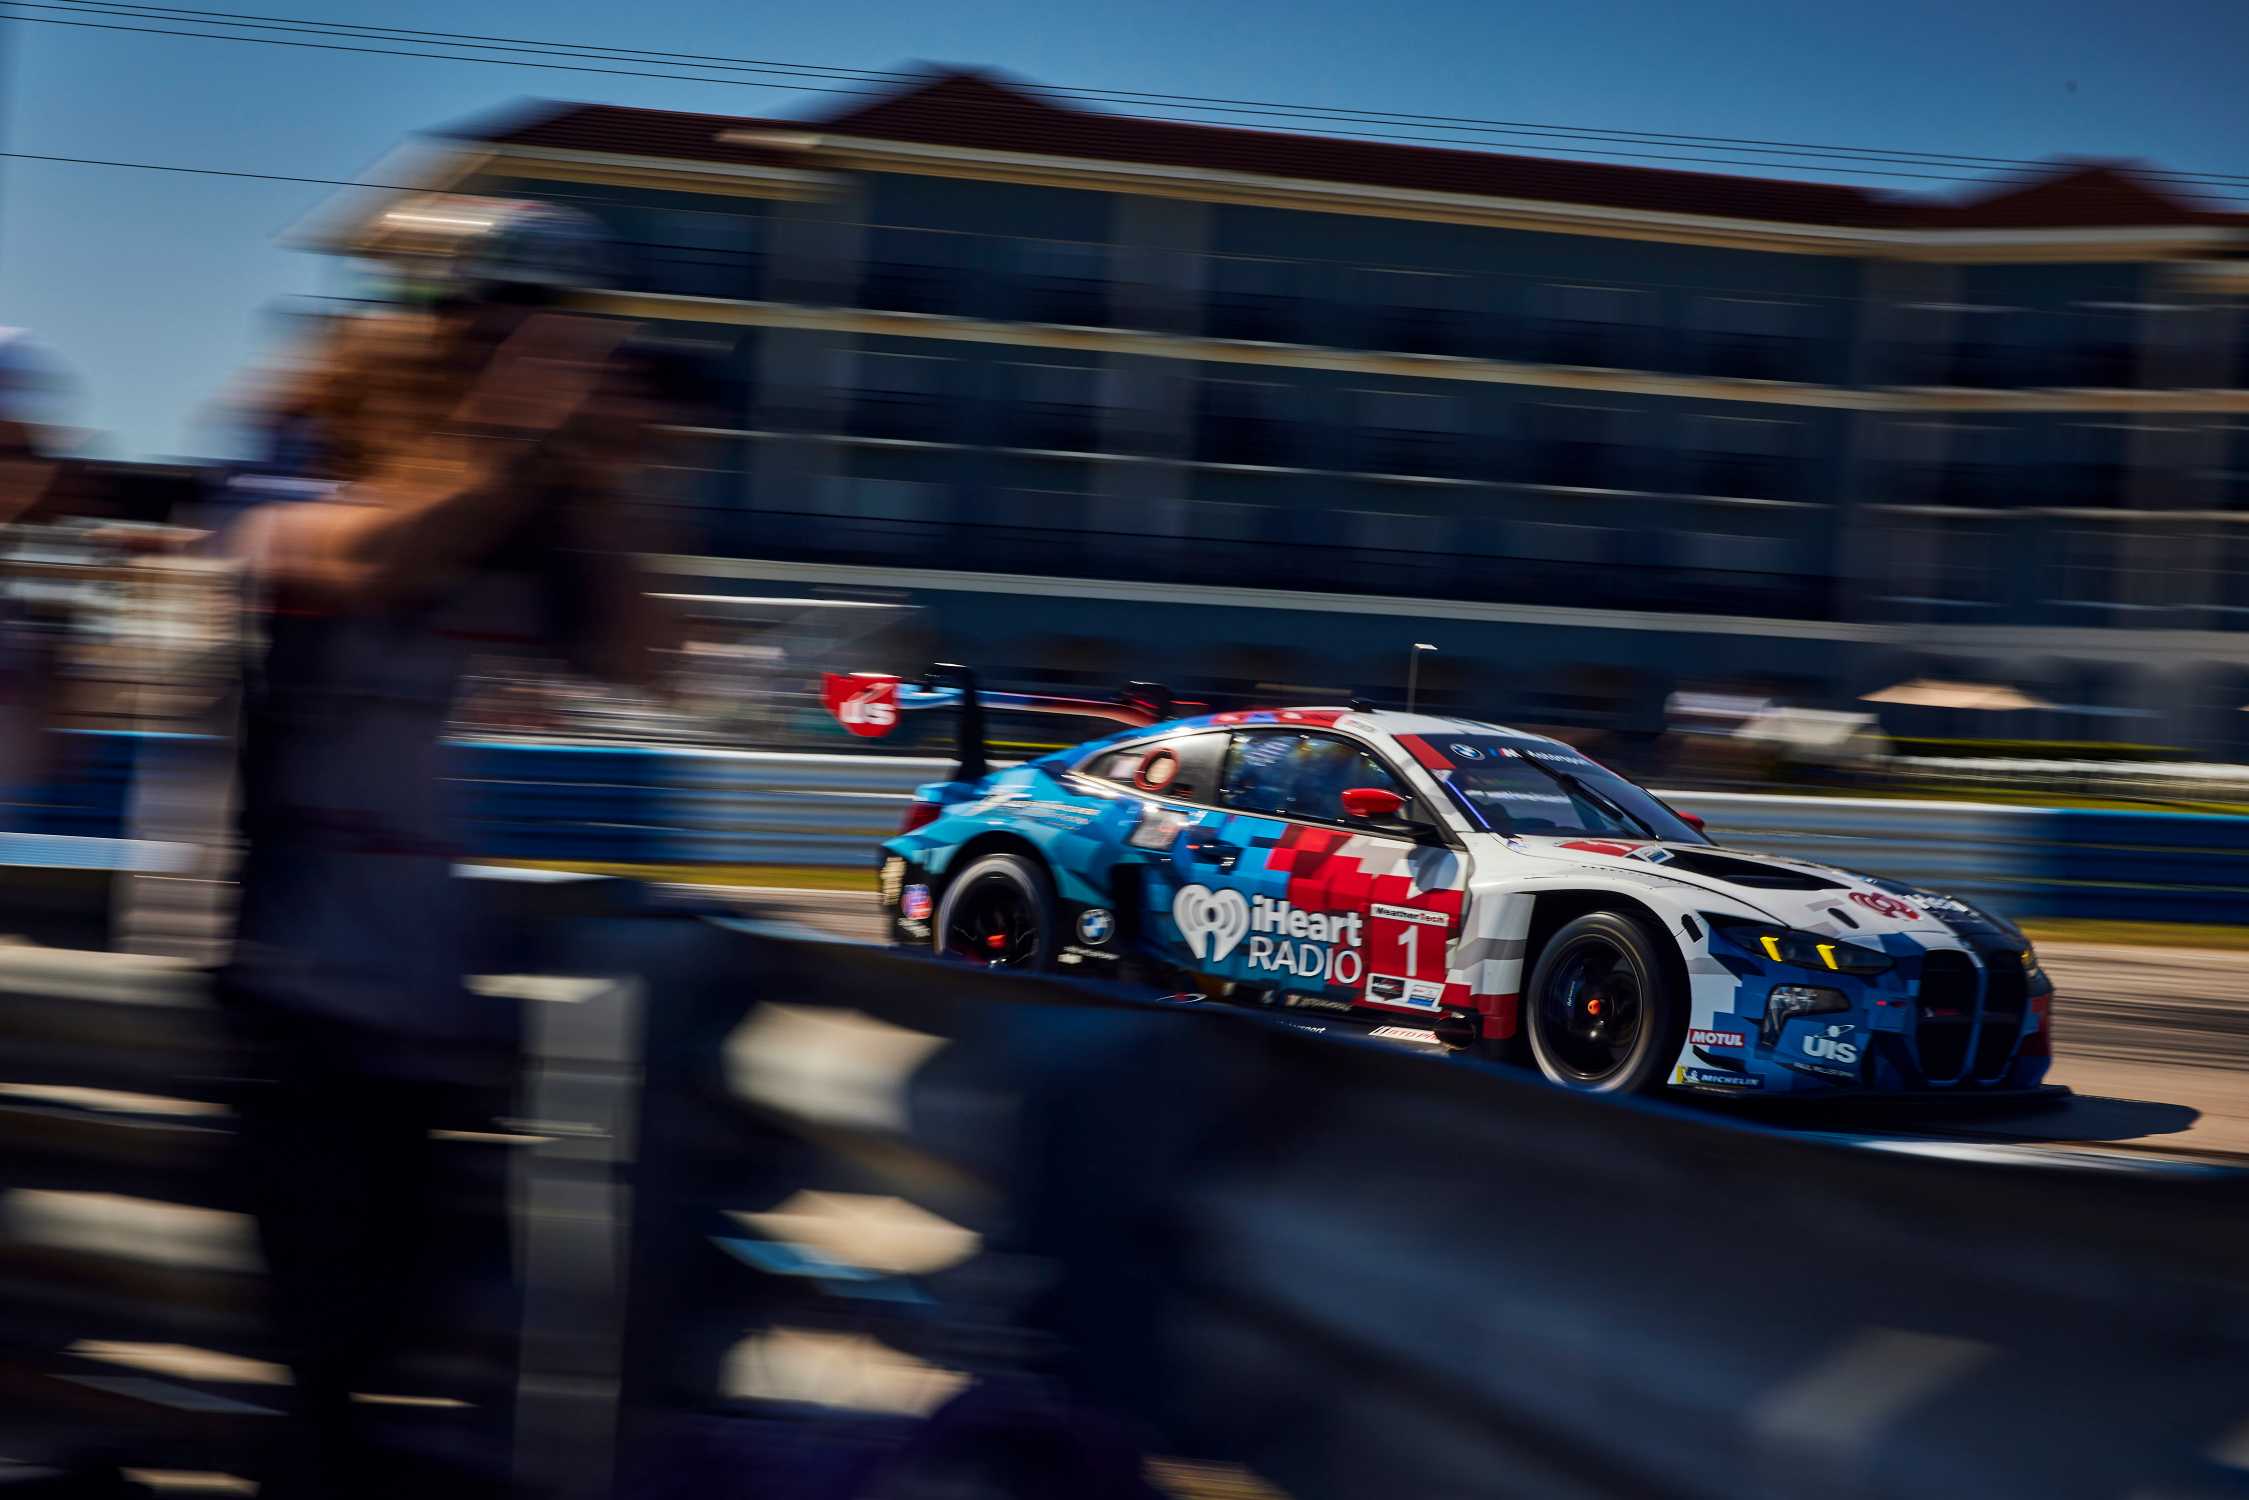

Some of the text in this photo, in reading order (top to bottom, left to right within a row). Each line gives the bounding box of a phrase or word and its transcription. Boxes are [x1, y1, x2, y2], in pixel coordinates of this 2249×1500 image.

[1252, 895, 1363, 946] iHeart
[1248, 936, 1363, 983] RADIO
[1398, 925, 1419, 977] 1
[1691, 1031, 1743, 1046] MOTUL
[1700, 1074, 1760, 1086] MICHELIN
